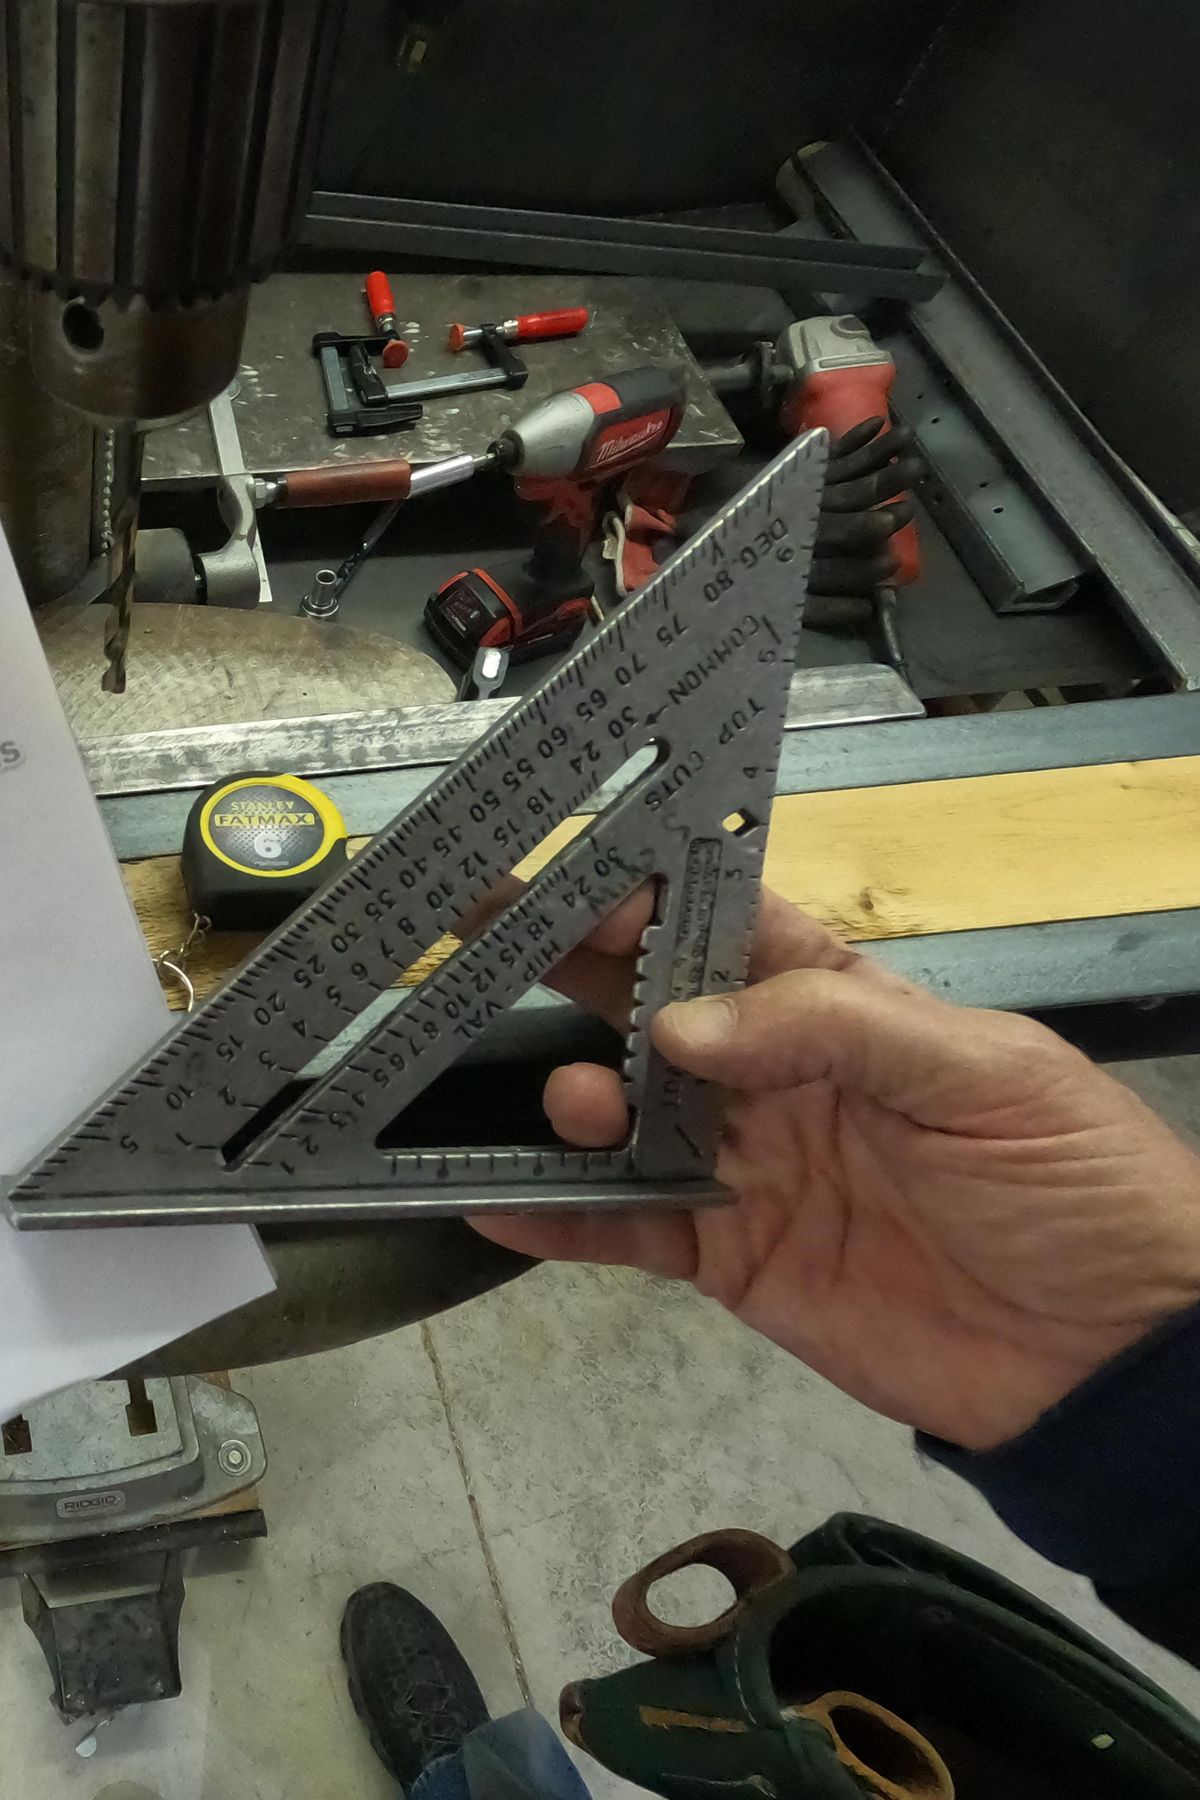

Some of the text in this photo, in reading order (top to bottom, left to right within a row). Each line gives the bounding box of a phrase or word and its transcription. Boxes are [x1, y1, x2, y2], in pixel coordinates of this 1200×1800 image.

[596, 420, 663, 462] Milwaukee
[703, 569, 734, 602] 80
[656, 615, 688, 646] 75
[615, 653, 647, 686] 70
[669, 615, 760, 706] COMMON
[576, 689, 607, 723] 65
[607, 706, 638, 739] 30
[537, 726, 567, 759] 60
[570, 739, 600, 774] 24
[645, 696, 766, 812] TOP CUTS
[503, 758, 535, 793] 55
[230, 801, 295, 811] STANLEY
[470, 789, 501, 823] 50
[527, 787, 554, 815] 18
[219, 814, 308, 825] FATMAX
[494, 819, 521, 847] 15
[254, 830, 282, 859] 6
[433, 825, 462, 857] 45
[400, 856, 428, 889] 40
[460, 852, 489, 879] 12
[425, 884, 455, 914] 10
[562, 874, 592, 908] 24
[364, 889, 397, 922] 35
[331, 922, 364, 954] 30
[398, 917, 416, 936] 8
[527, 915, 554, 941] 18
[380, 939, 395, 959] 7
[500, 939, 528, 967] 15
[294, 954, 326, 988] 25
[351, 961, 369, 982] 6
[470, 966, 498, 994] 12
[711, 970, 730, 984] 2
[326, 984, 345, 1004] 5
[445, 993, 472, 1020] 10
[254, 992, 286, 1026] 20
[292, 1019, 307, 1038] 4
[423, 1022, 440, 1039] 8
[216, 1034, 244, 1062] 15
[258, 1050, 277, 1071] 3
[409, 1038, 425, 1055] 7
[389, 1052, 406, 1071] 6
[373, 1069, 390, 1088] 5
[166, 1083, 195, 1110] 10
[218, 1085, 237, 1106] 2
[352, 1090, 366, 1109] 4
[328, 1110, 348, 1129] 3
[120, 1135, 138, 1154] 5
[302, 1134, 320, 1154] 2
[64, 1495, 117, 1510] RIDGID
